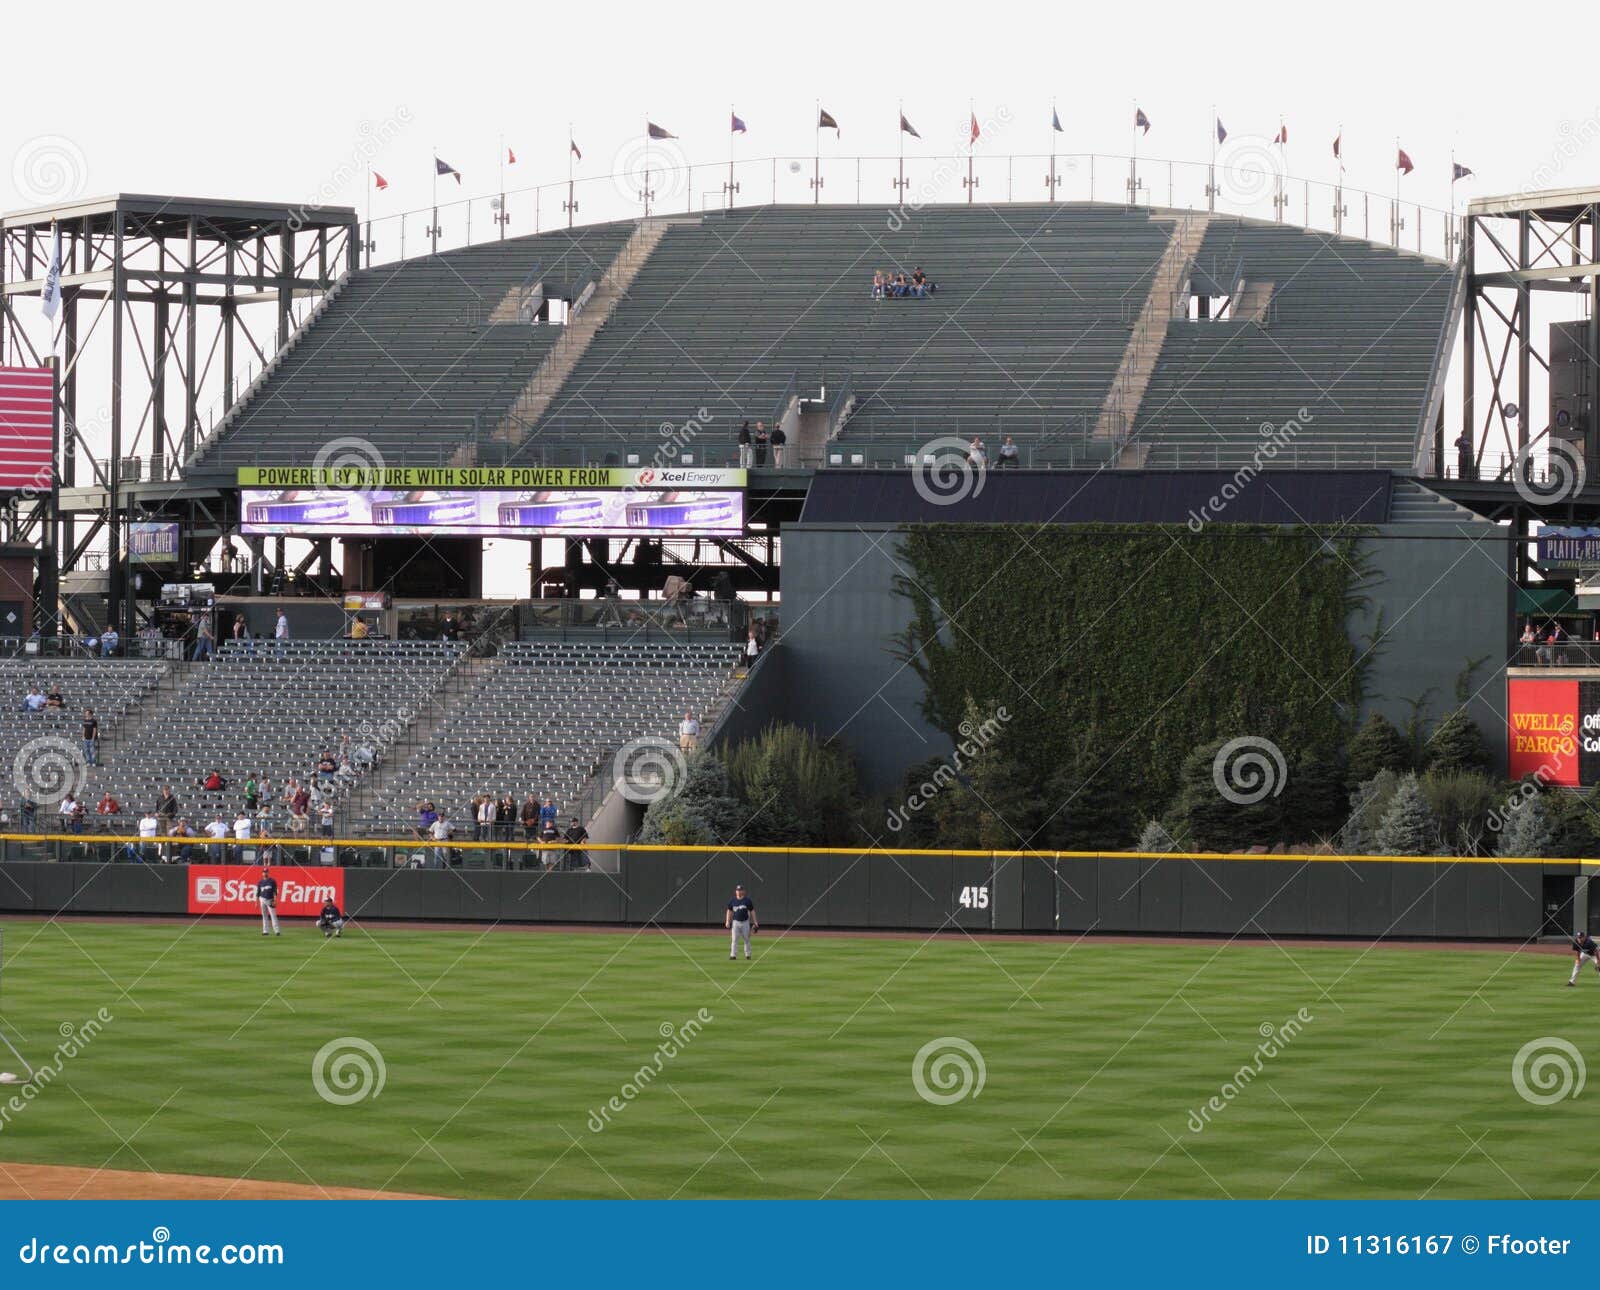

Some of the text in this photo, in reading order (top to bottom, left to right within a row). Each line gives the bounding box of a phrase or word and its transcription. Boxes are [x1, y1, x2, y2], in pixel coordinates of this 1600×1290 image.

[257, 468, 327, 485] POWERED
[334, 468, 352, 485] BY
[357, 468, 412, 485] NATURE
[418, 469, 454, 485] WITH
[460, 469, 505, 485] SOLAR
[512, 469, 564, 485] POWER
[570, 469, 610, 485] FROM
[1546, 540, 1580, 559] PLATTE
[1513, 713, 1575, 731] WELLS
[1515, 736, 1574, 753] FARGO
[224, 879, 336, 903] Sta Farm
[959, 886, 989, 909] 415
